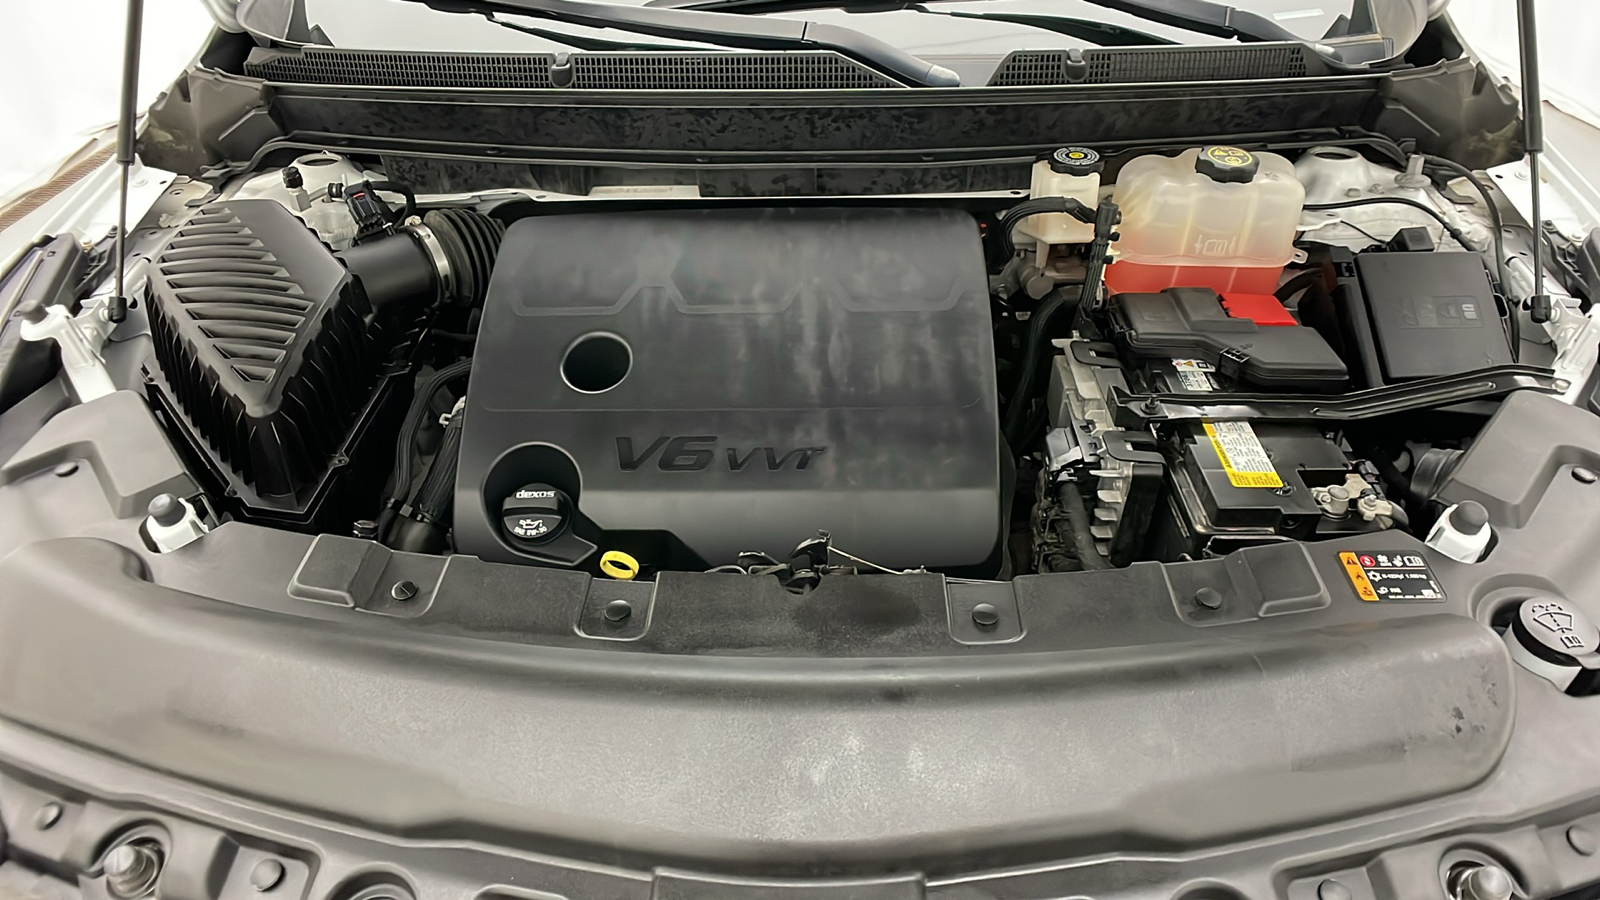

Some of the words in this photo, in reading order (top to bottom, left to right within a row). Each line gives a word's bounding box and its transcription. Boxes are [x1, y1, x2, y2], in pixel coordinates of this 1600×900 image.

[615, 436, 718, 471] V6
[726, 447, 827, 471] VVT
[516, 490, 556, 498] dexos
